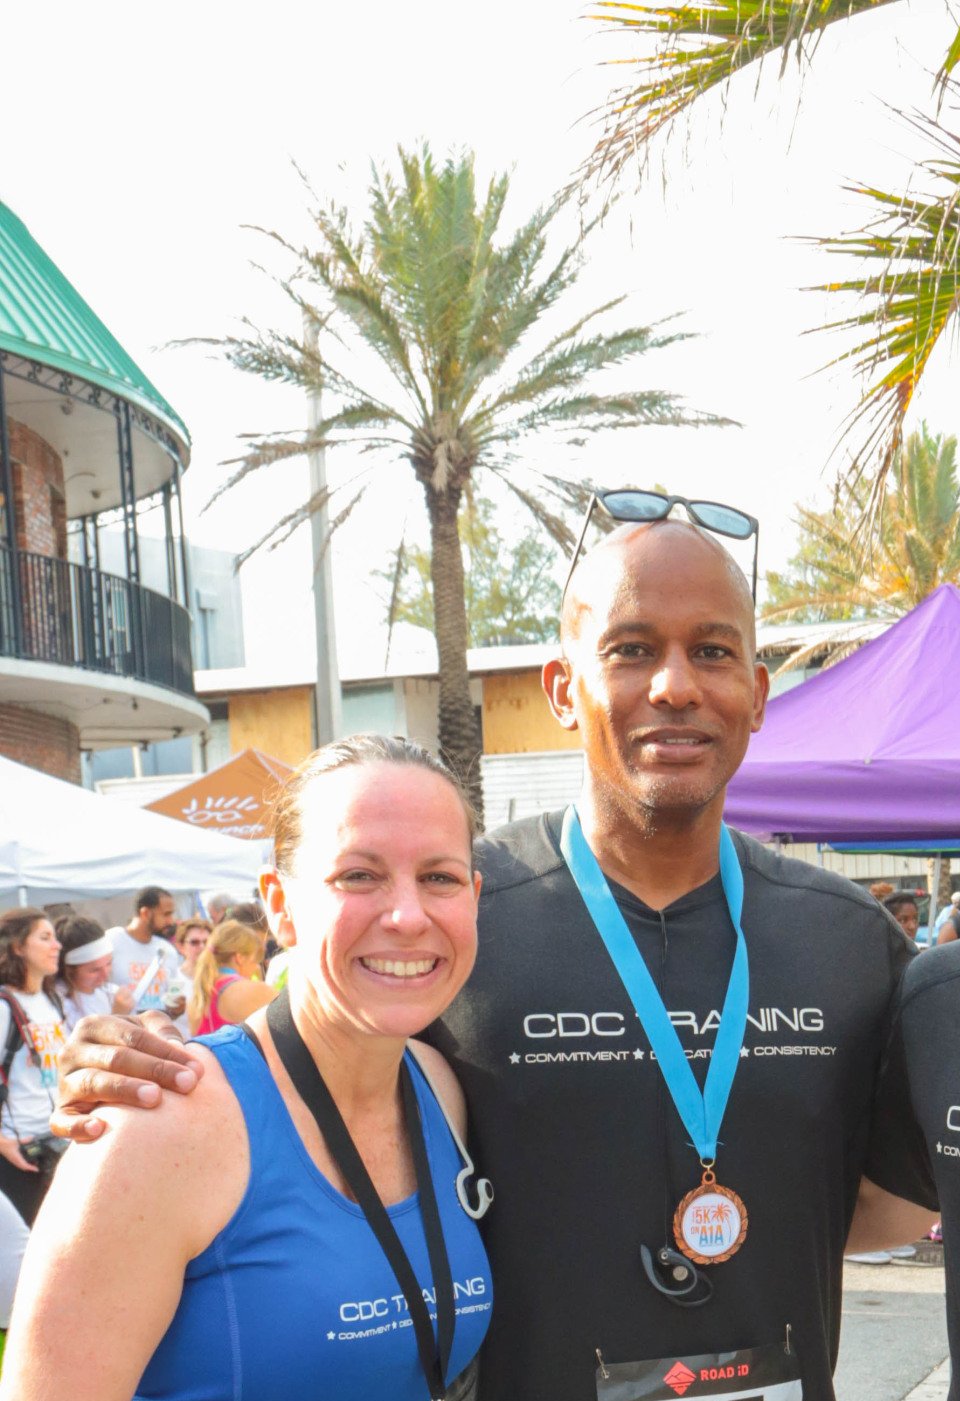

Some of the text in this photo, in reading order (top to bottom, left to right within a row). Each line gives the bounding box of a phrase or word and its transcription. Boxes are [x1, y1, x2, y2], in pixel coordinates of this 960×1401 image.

[523, 1012, 626, 1038] CDC
[525, 1051, 629, 1063] COMMITMENT
[754, 1046, 837, 1056] CONSISTENCY
[340, 1299, 388, 1322] CDC
[338, 1324, 391, 1340] COMMITMENT
[700, 1366, 735, 1381] ROAD
